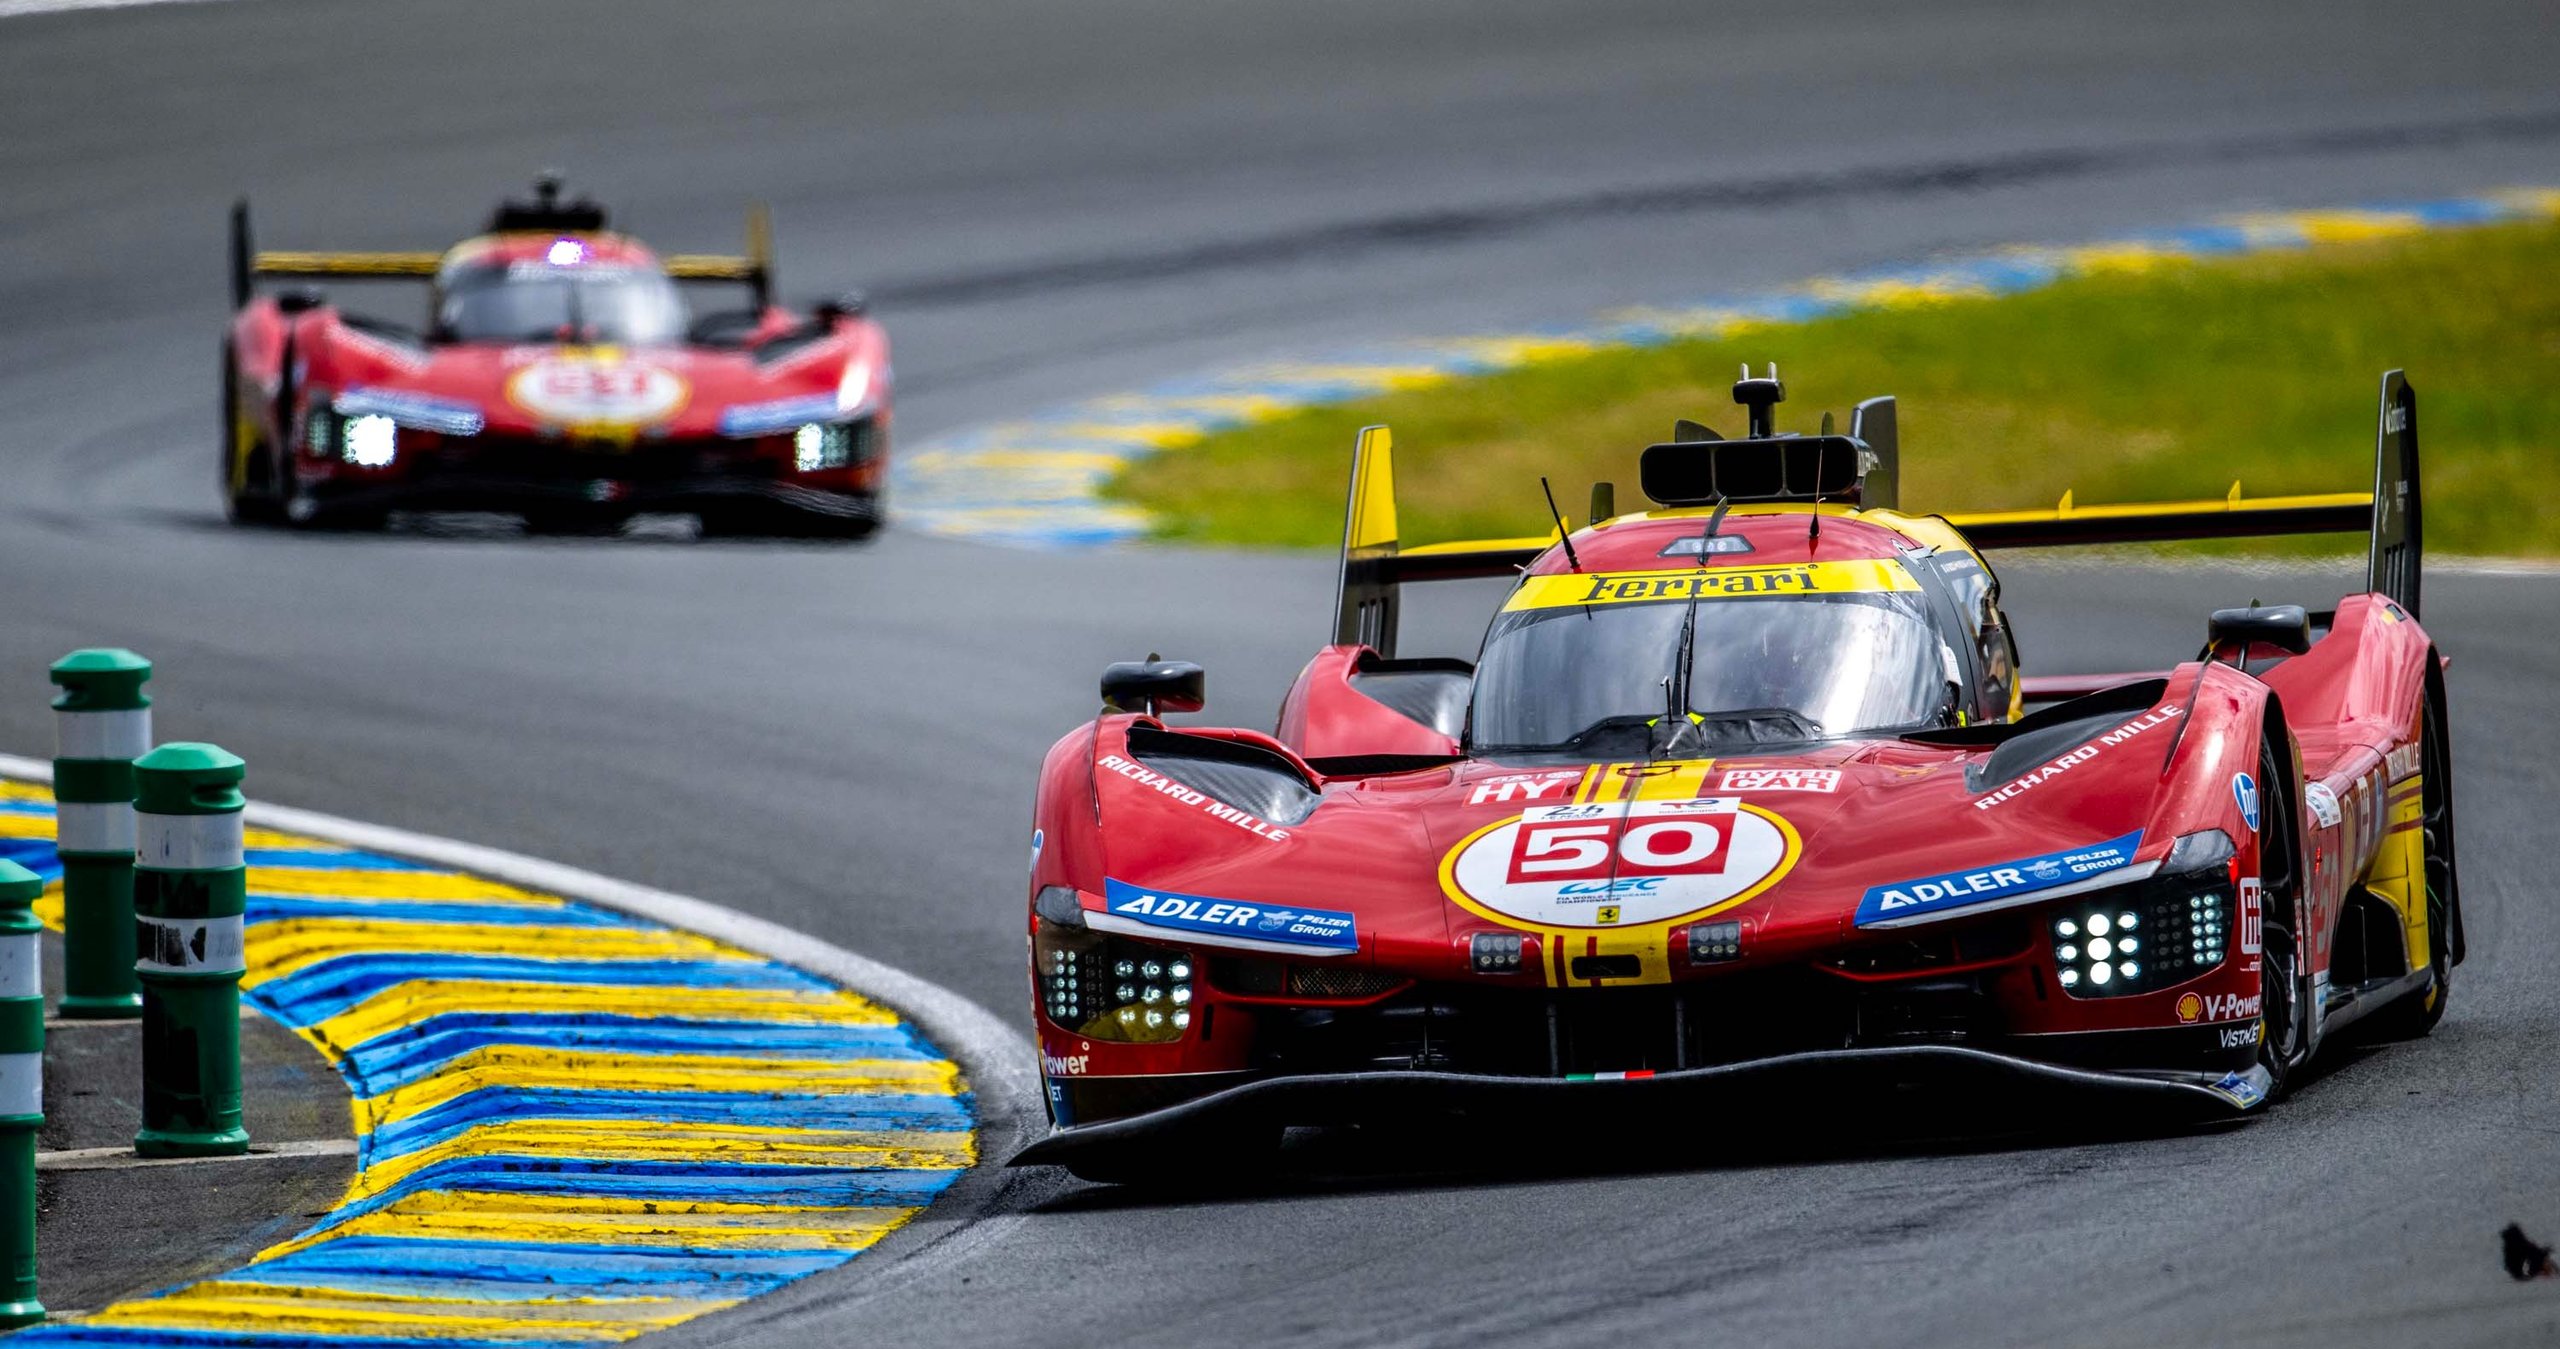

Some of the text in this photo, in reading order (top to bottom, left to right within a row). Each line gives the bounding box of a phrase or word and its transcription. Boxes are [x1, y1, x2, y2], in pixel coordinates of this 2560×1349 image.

[1579, 566, 1820, 602] Ferrari
[1973, 703, 2185, 811] RICHARD MILLE
[1728, 777, 1830, 790] CAR
[1731, 771, 1833, 779] HYPER
[1098, 754, 1291, 842] RICHARD MILLE
[1469, 778, 1564, 805] HY
[2236, 774, 2257, 830] hp
[1520, 821, 1721, 874] 50
[2062, 848, 2120, 865] PELZER
[2070, 856, 2126, 874] GROUP
[1879, 867, 2028, 911] ADLER
[1115, 895, 1259, 927] ADLER
[1298, 914, 1352, 928] PELZER
[1289, 923, 1342, 937] GROUP
